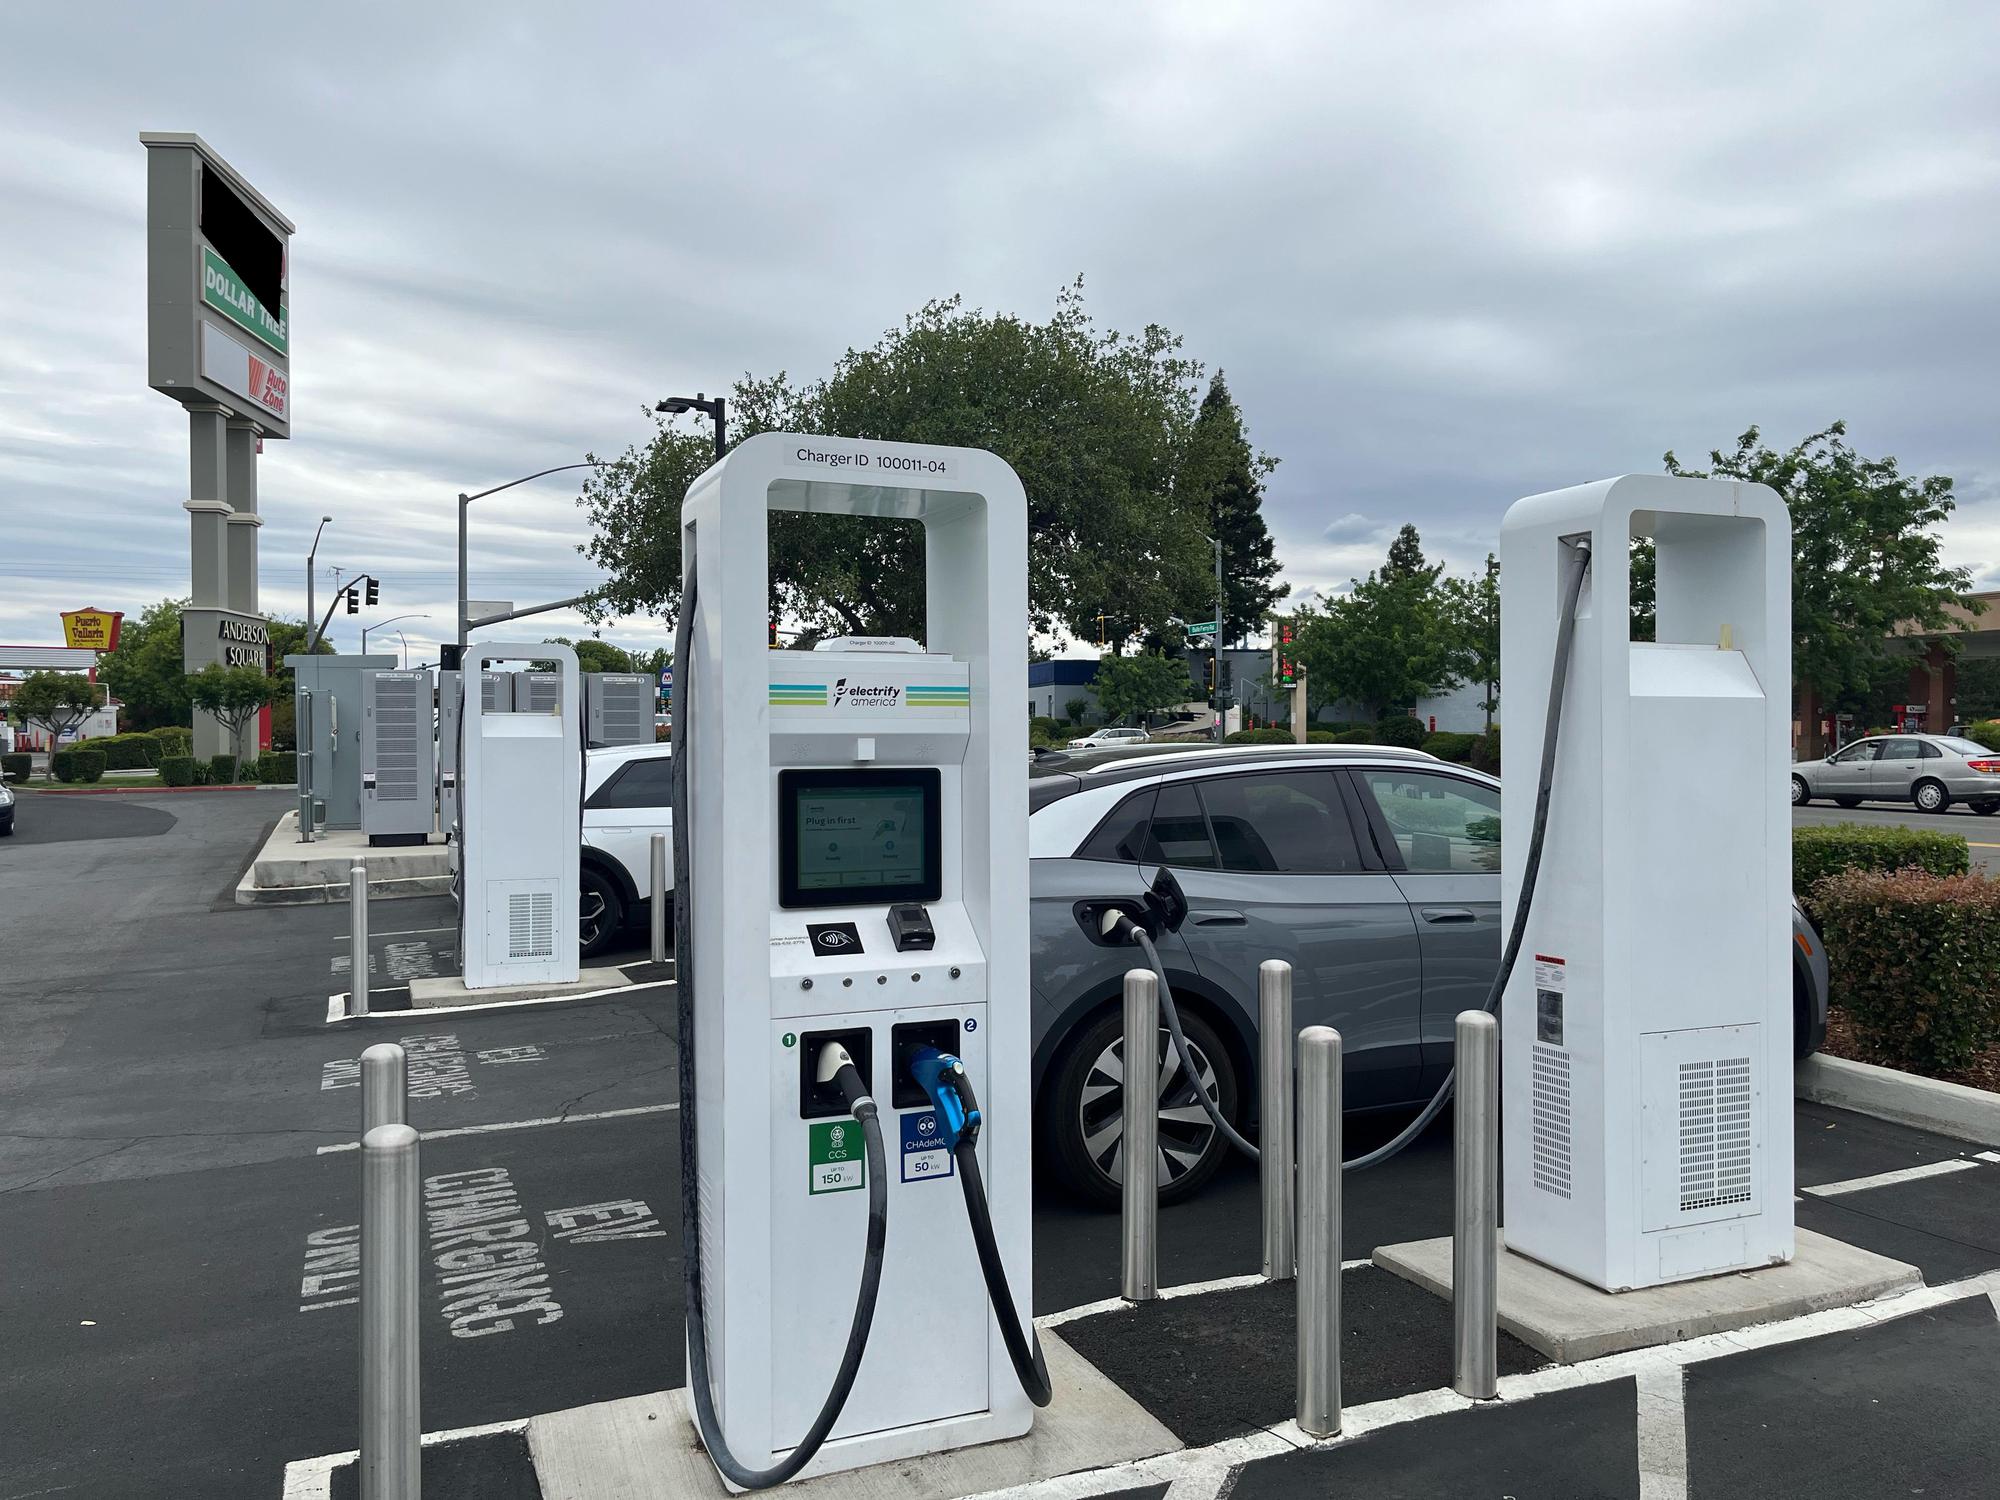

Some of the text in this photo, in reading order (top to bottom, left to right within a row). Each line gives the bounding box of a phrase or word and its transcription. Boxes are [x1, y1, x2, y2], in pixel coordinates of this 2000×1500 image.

[206, 265, 255, 319] DOLLAR
[266, 368, 287, 394] Auto
[262, 385, 284, 413] Zone
[797, 449, 947, 473] Charger ID 100011-04
[75, 616, 101, 627] Puerto
[72, 627, 105, 639] Vallarta
[223, 620, 270, 645] ANDERSON
[230, 646, 264, 669] SQUARE
[850, 686, 900, 698] electrify
[851, 697, 896, 707] america
[806, 816, 856, 826] Plug in first
[828, 1149, 847, 1160] CCS
[915, 1162, 929, 1172] 50
[821, 1173, 842, 1184] 150
[544, 1198, 668, 1244] EV
[424, 1167, 564, 1338] CHARGING
